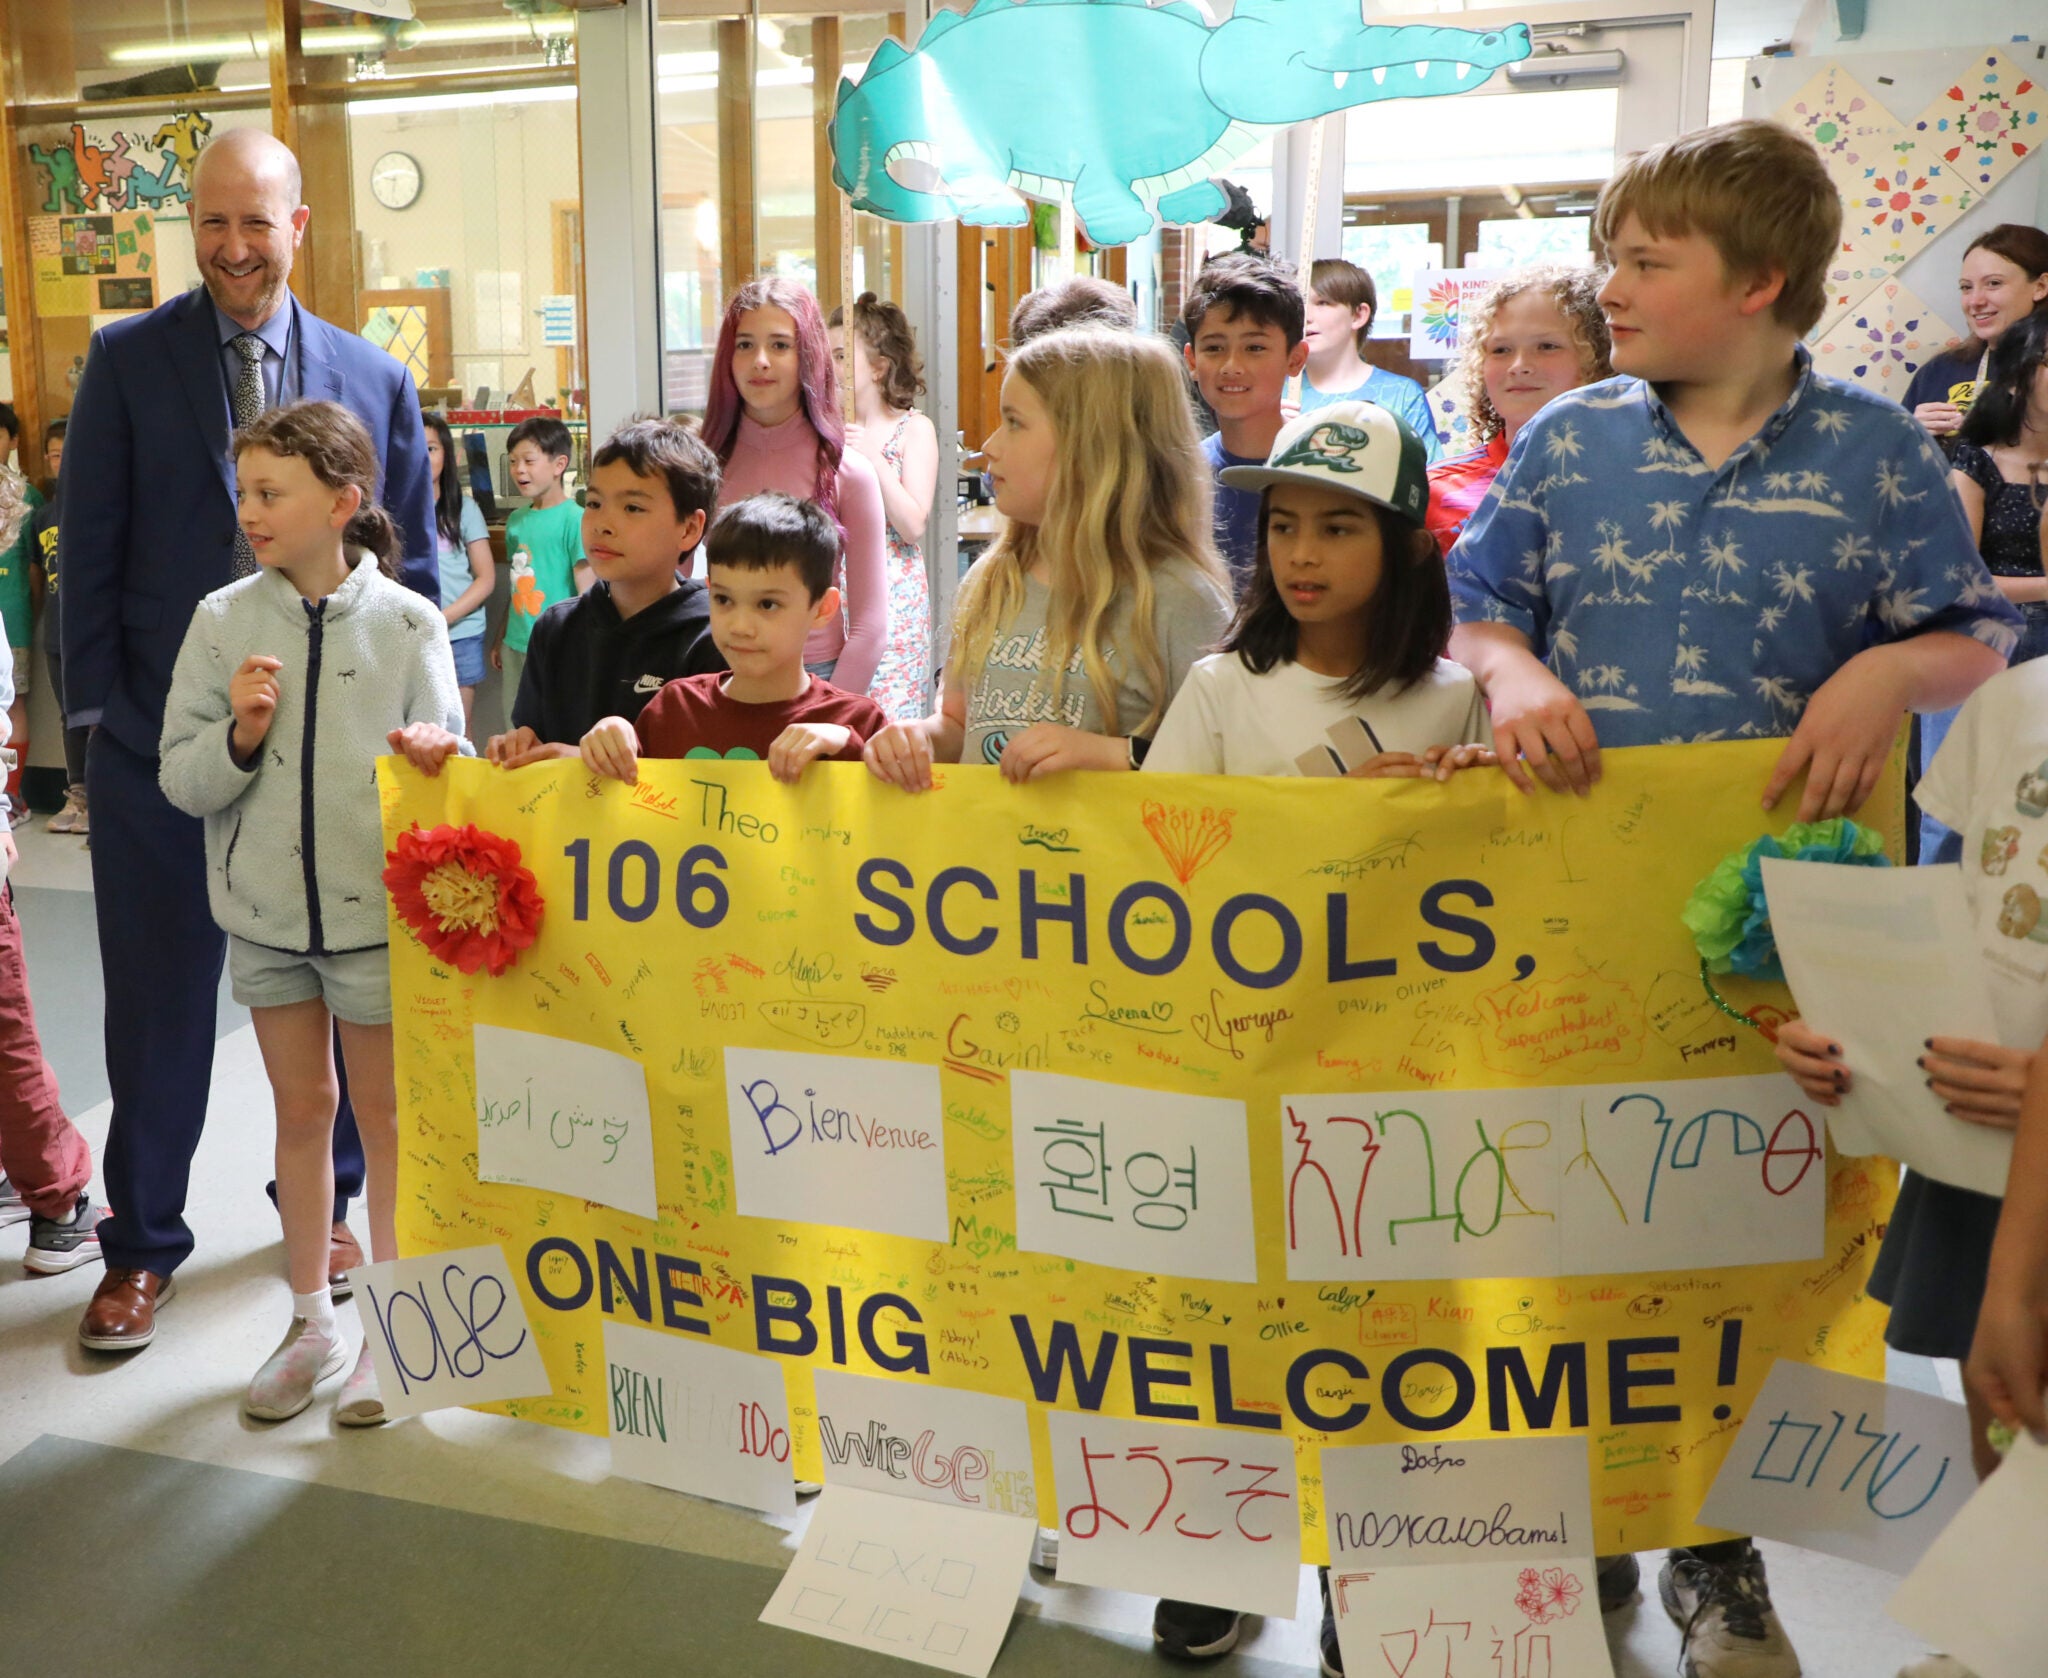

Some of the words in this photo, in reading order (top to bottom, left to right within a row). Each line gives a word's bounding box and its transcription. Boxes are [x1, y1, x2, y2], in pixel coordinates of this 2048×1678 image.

[690, 779, 779, 843] Theo
[564, 838, 730, 929] 106
[854, 857, 1537, 990] SCHOOLS,
[1033, 1117, 1198, 1222] 환영
[526, 1236, 712, 1336] ONE
[750, 1272, 931, 1376] BIG
[1010, 1315, 1744, 1433] WELCOME!
[1065, 1436, 1291, 1541] ようこそ
[1751, 1410, 1951, 1519] שלום
